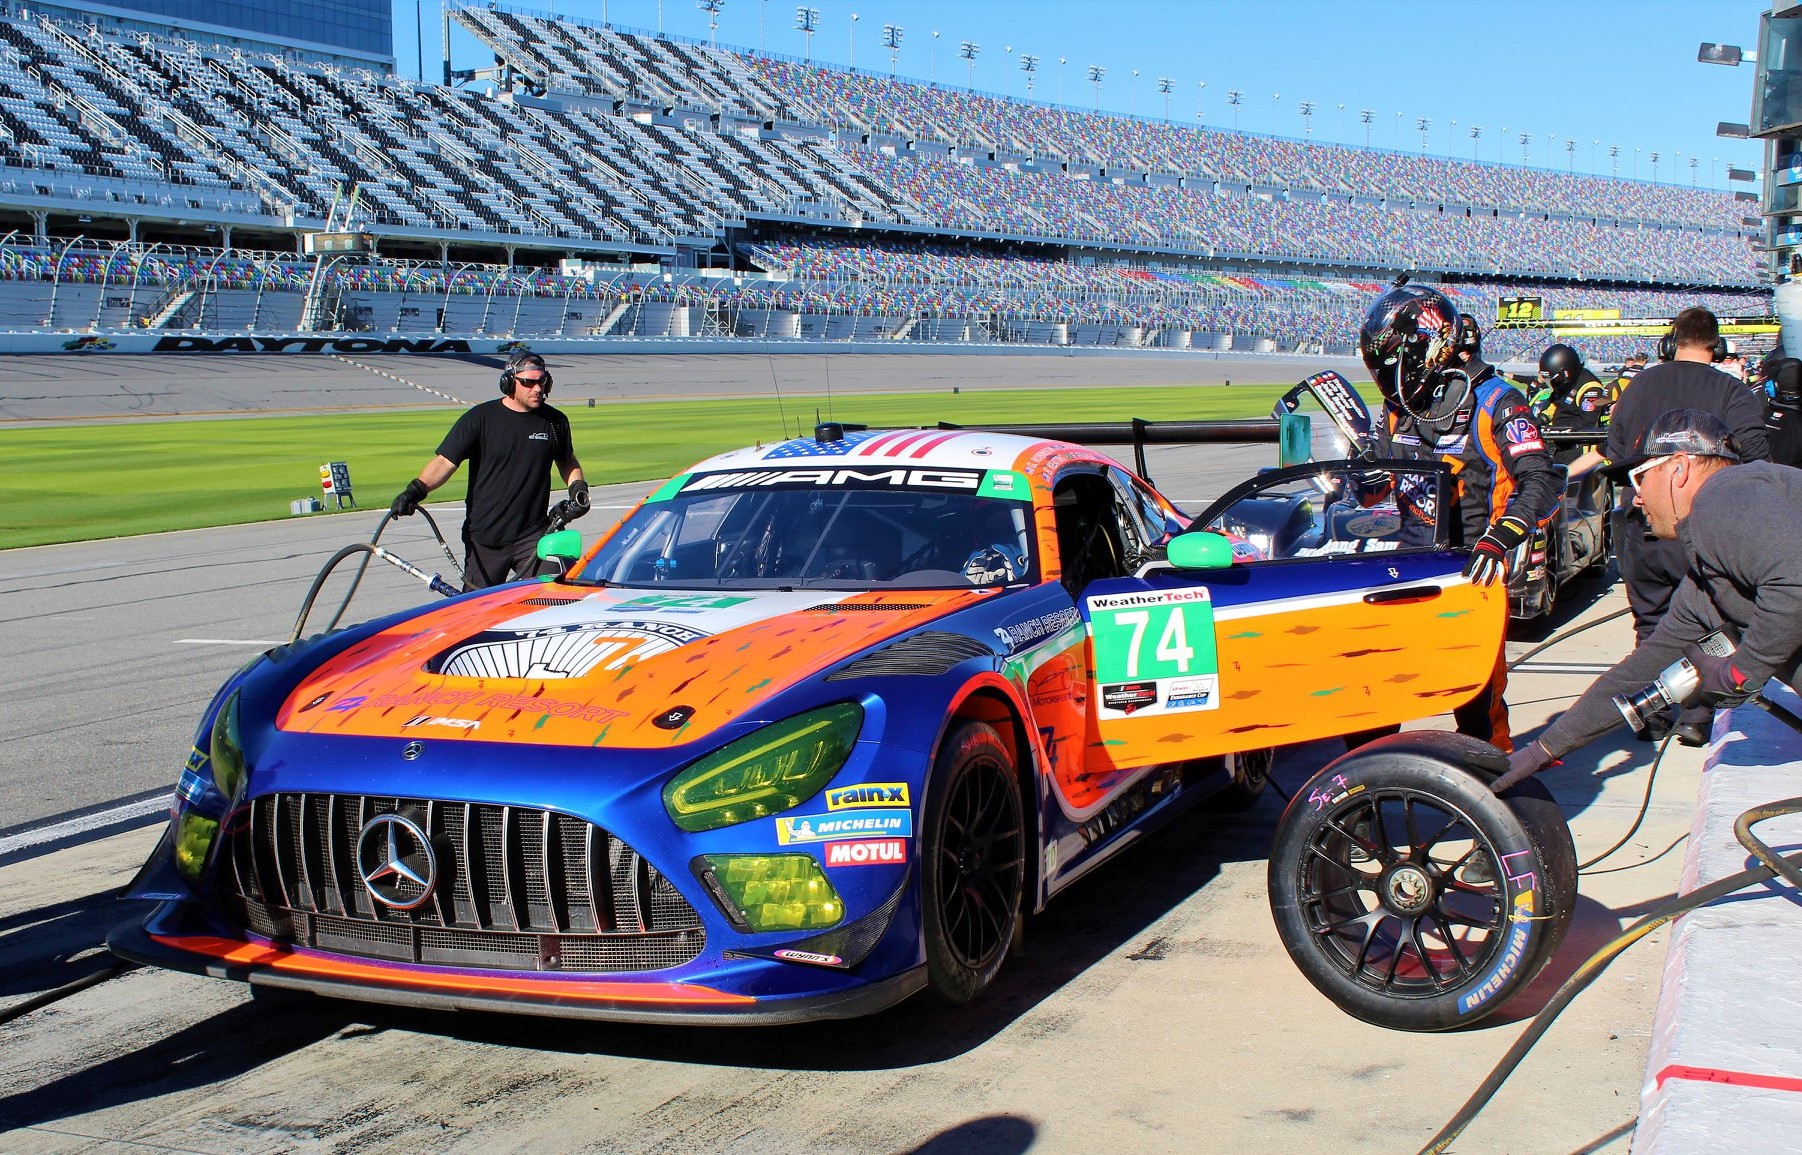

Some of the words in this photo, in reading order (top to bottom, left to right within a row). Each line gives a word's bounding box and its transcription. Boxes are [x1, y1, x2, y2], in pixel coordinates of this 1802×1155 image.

[1507, 302, 1533, 317] 12
[151, 335, 472, 352] DAYTONA
[1509, 440, 1543, 455] MOTUL
[757, 469, 980, 490] AMG
[1093, 590, 1206, 608] WeatherTech
[577, 621, 702, 642] RANCH
[1114, 606, 1194, 678] 74
[364, 690, 475, 709] RANCH
[475, 692, 632, 725] RESORT
[817, 818, 903, 834] MICHELIN
[829, 842, 903, 864] MOTUL
[1464, 928, 1528, 1009] MICHELIN
